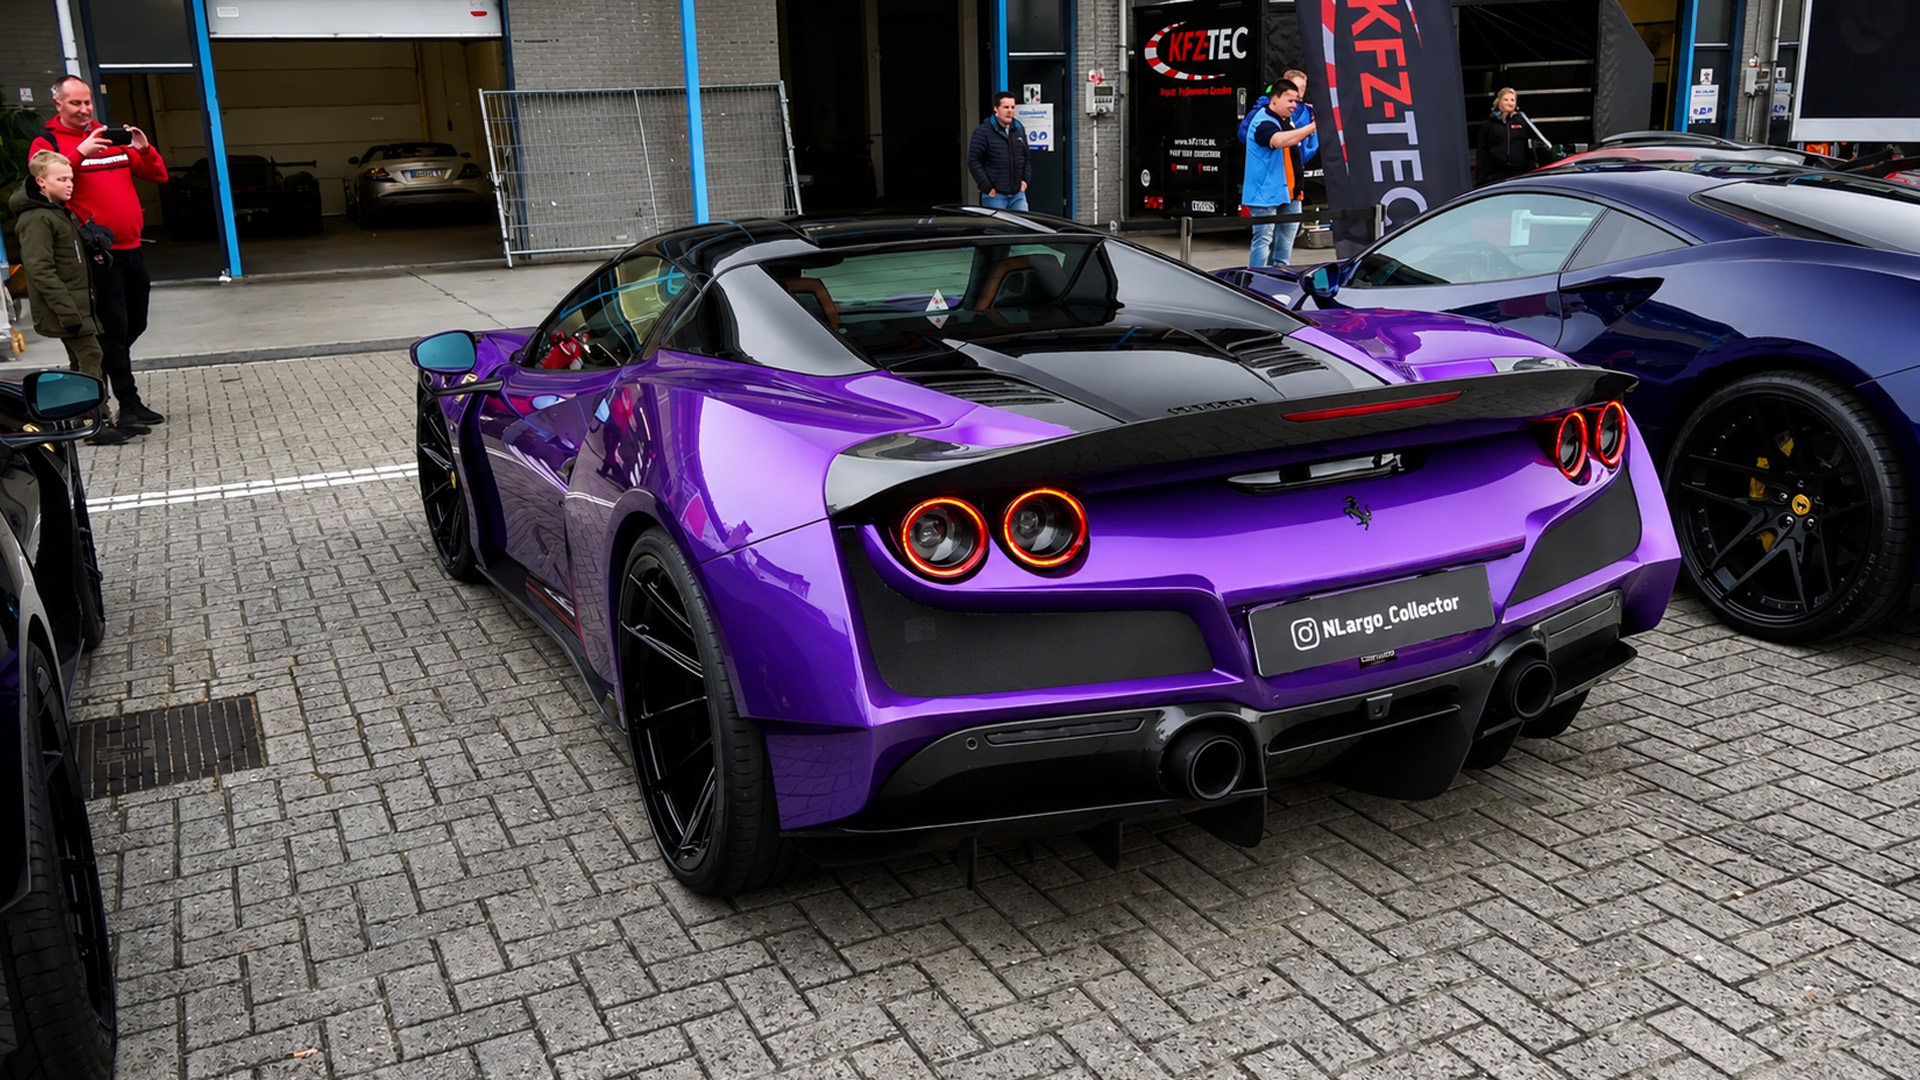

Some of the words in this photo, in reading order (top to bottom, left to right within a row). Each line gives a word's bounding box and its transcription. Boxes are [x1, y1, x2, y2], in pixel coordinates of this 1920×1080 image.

[1168, 26, 1249, 62] KFZ-TEC
[1347, 0, 1428, 226] KFZ-TEC
[1322, 595, 1459, 639] NLargo_Collector
